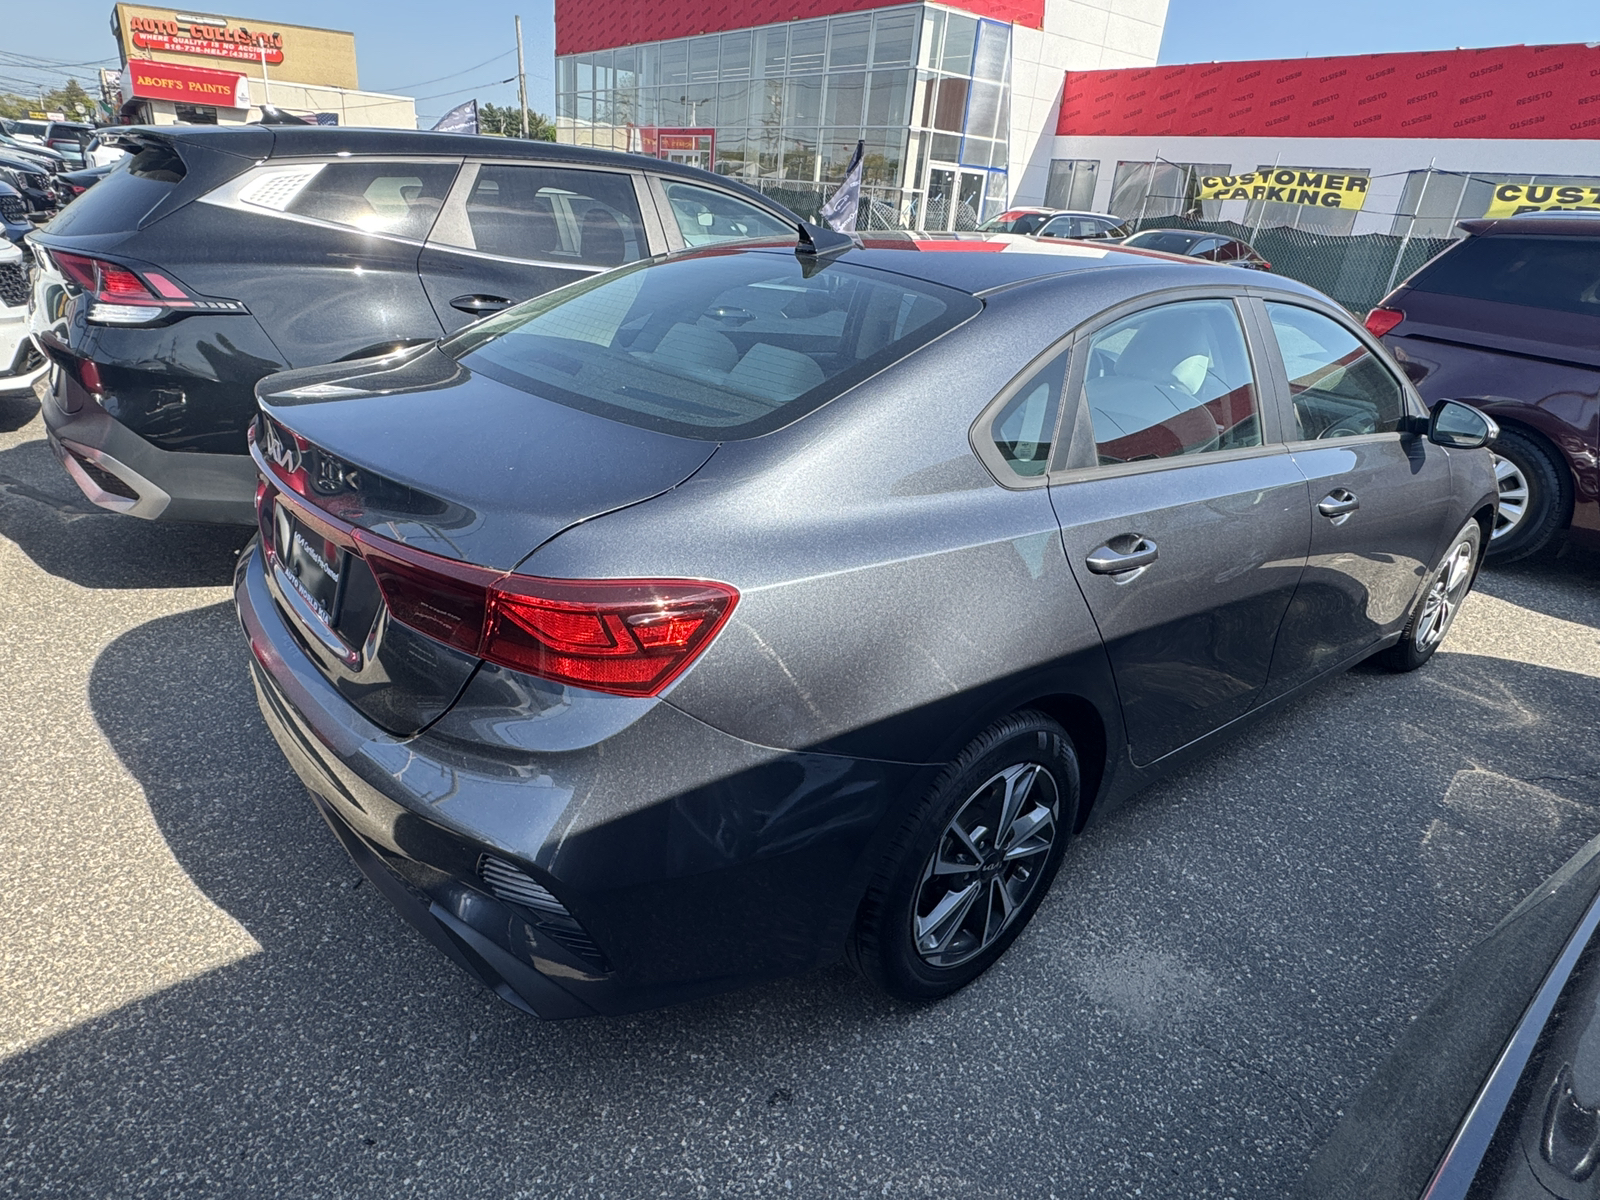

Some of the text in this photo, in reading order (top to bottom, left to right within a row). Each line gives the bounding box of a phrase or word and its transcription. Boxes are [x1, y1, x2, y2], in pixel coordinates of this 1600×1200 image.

[131, 16, 179, 36] AUTO
[139, 32, 170, 42] WHERE
[172, 37, 209, 47] QUALITY
[238, 45, 279, 55] ACCIDENT
[137, 75, 184, 90] ABOFF'S
[188, 81, 231, 95] PAINTS
[1406, 90, 1438, 106] RESISTO
[1459, 90, 1493, 105] RESISTO
[1516, 90, 1553, 106] RESISTO
[1578, 94, 1600, 105] RESI
[1453, 113, 1487, 128] RESISTO
[1509, 115, 1545, 131] RESISTO
[1202, 168, 1369, 193] CUSTOMER
[1212, 185, 1343, 208] PARKING
[285, 568, 329, 625] AUTO WORLD KIA
